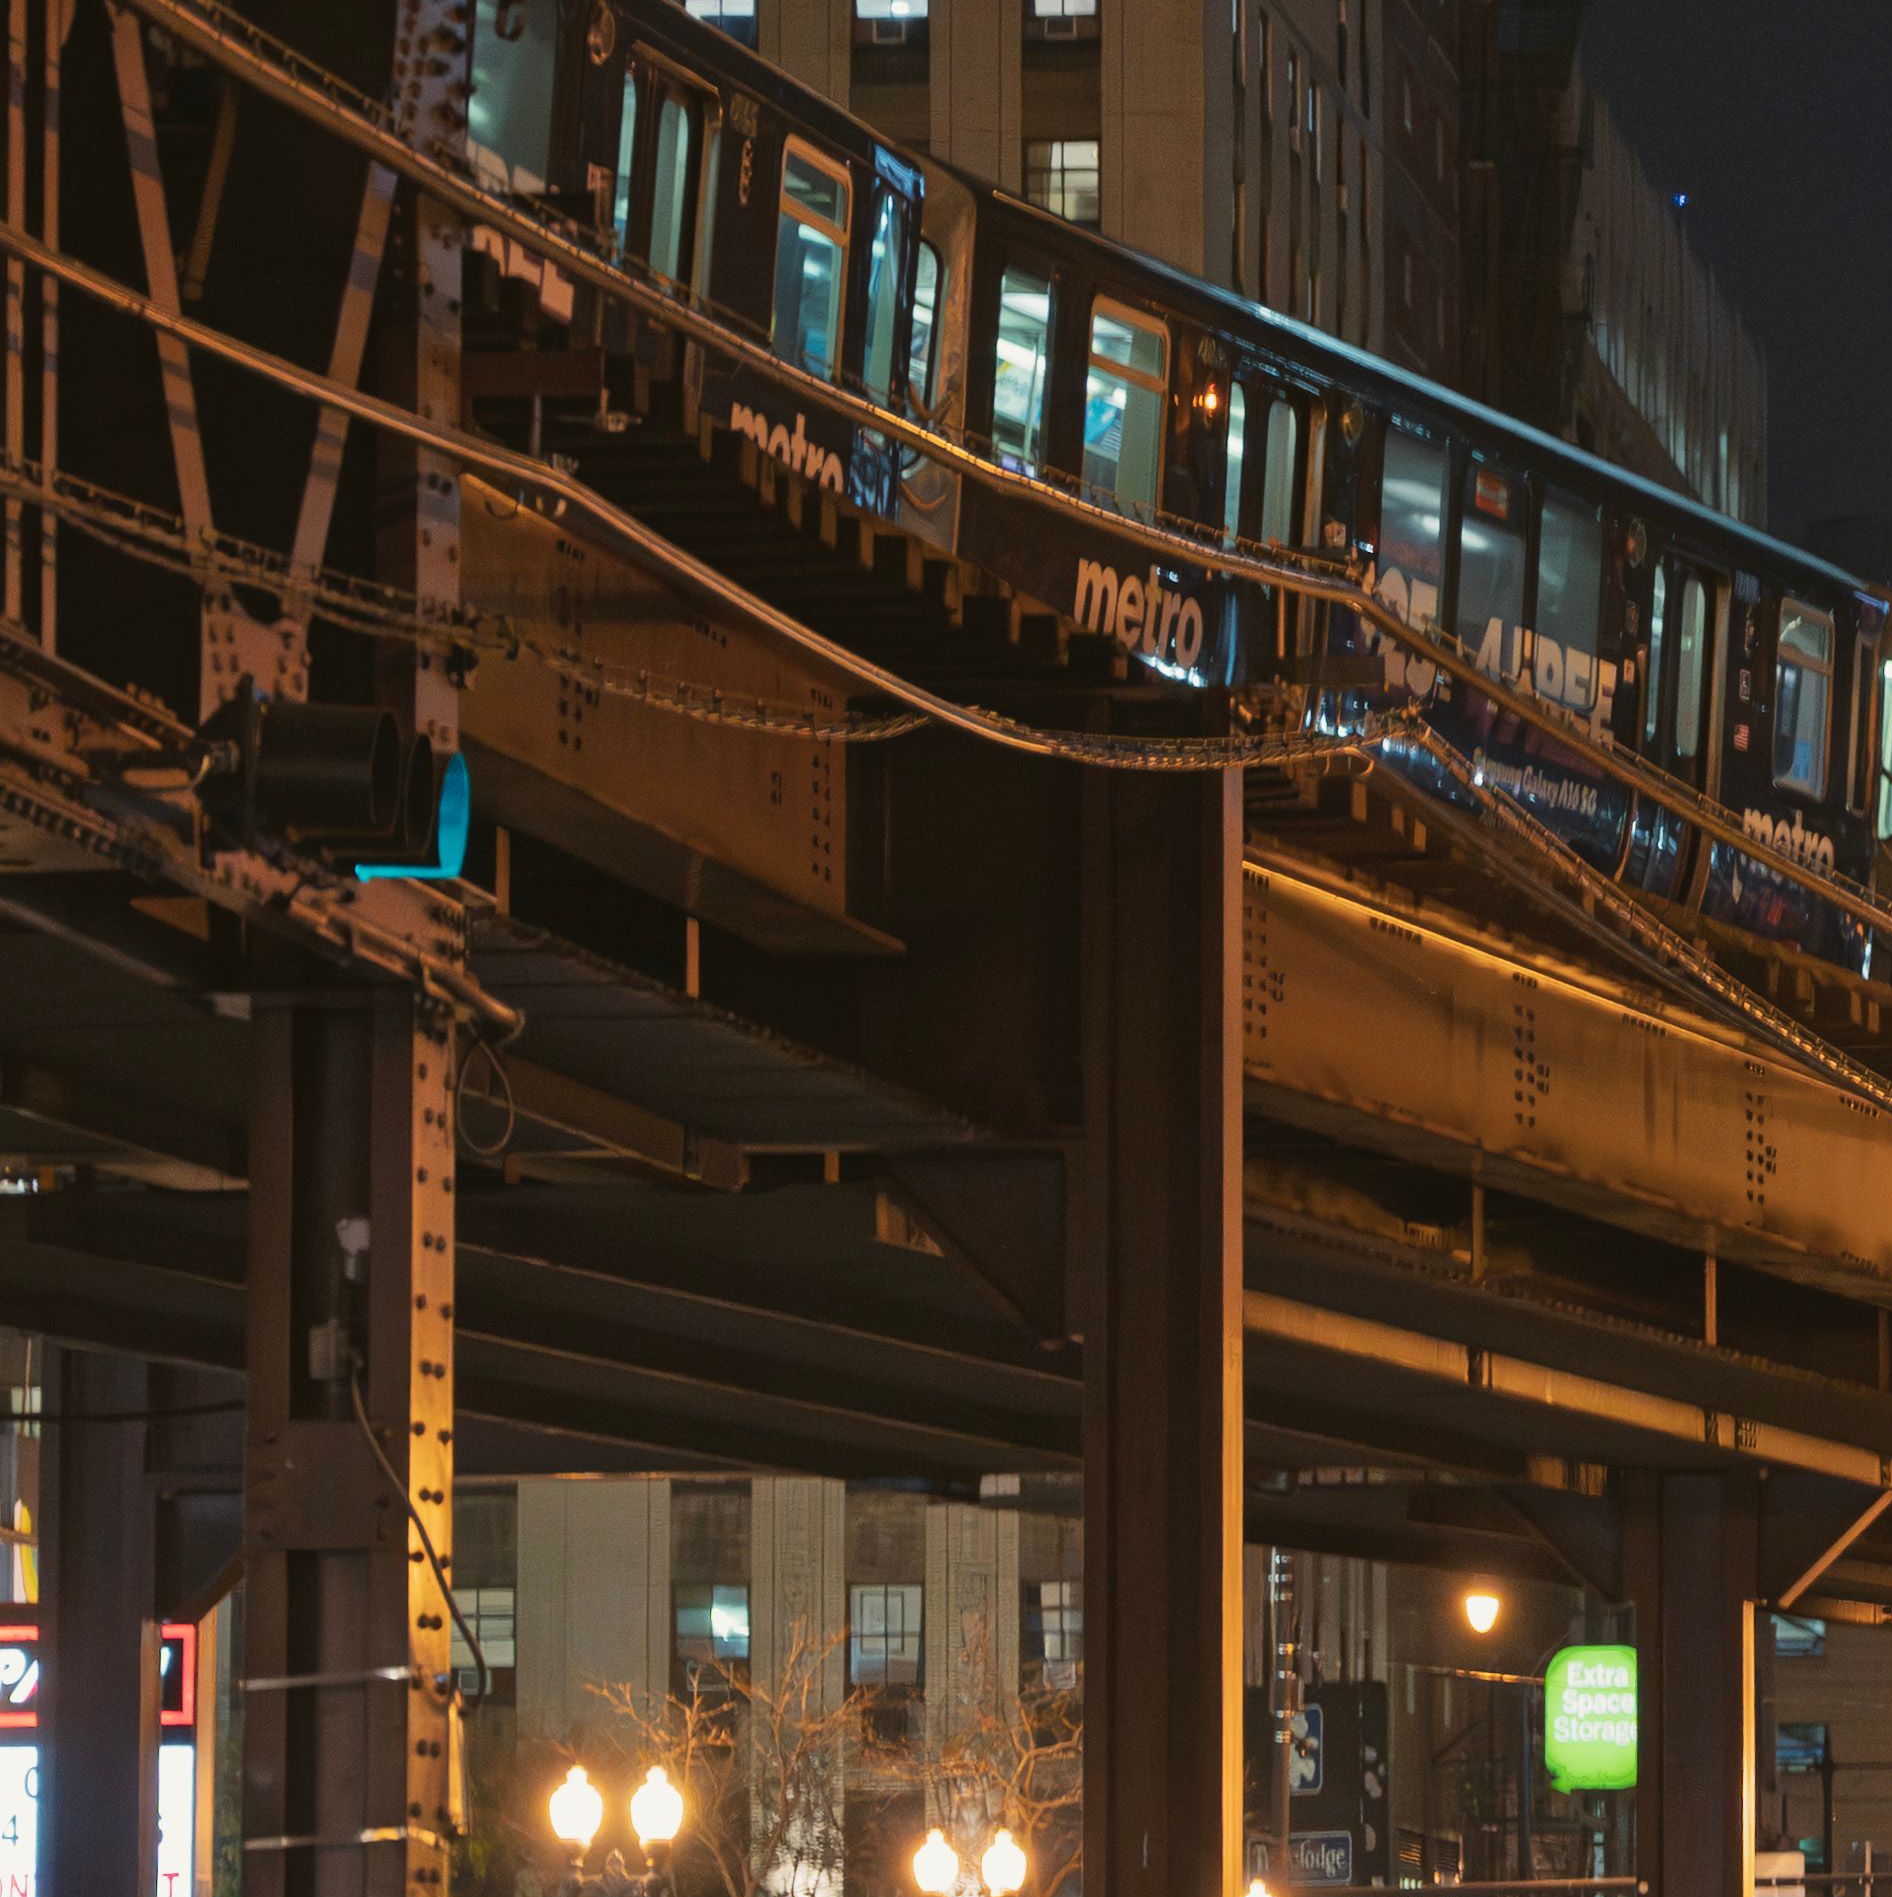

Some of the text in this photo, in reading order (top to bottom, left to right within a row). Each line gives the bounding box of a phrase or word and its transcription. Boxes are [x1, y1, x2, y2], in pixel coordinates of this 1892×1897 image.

[1074, 558, 1203, 668] metro
[1567, 1660, 1630, 1688] Extra
[1562, 1688, 1636, 1719] Space
